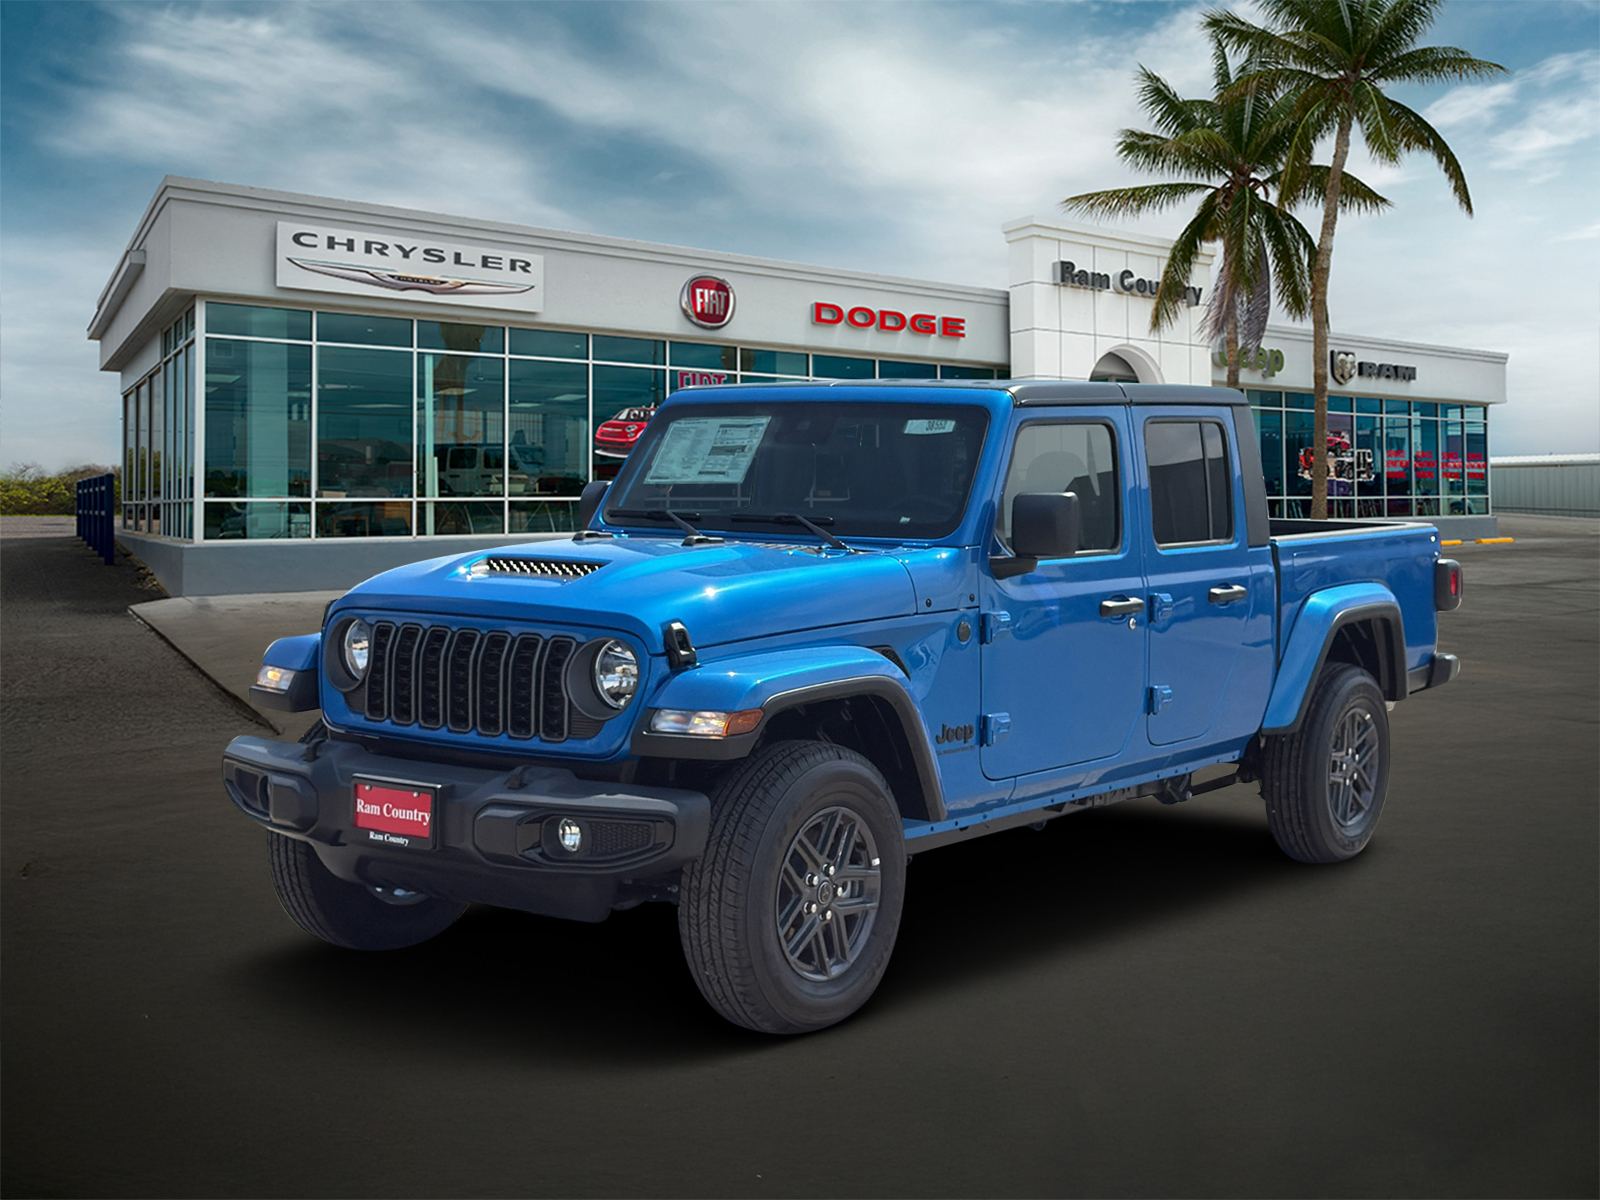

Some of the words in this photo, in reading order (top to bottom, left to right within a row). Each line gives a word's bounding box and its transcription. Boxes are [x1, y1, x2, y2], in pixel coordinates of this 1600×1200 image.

[292, 232, 533, 273] CHRYSLER
[1053, 260, 1111, 290] Ram
[695, 287, 728, 316] FIAT
[811, 302, 967, 338] DODGE
[1358, 361, 1417, 381] RAM
[936, 723, 974, 744] Jeep
[356, 798, 380, 815] Ram
[383, 803, 431, 826] Country
[369, 831, 383, 842] Ram
[384, 834, 409, 846] Country
